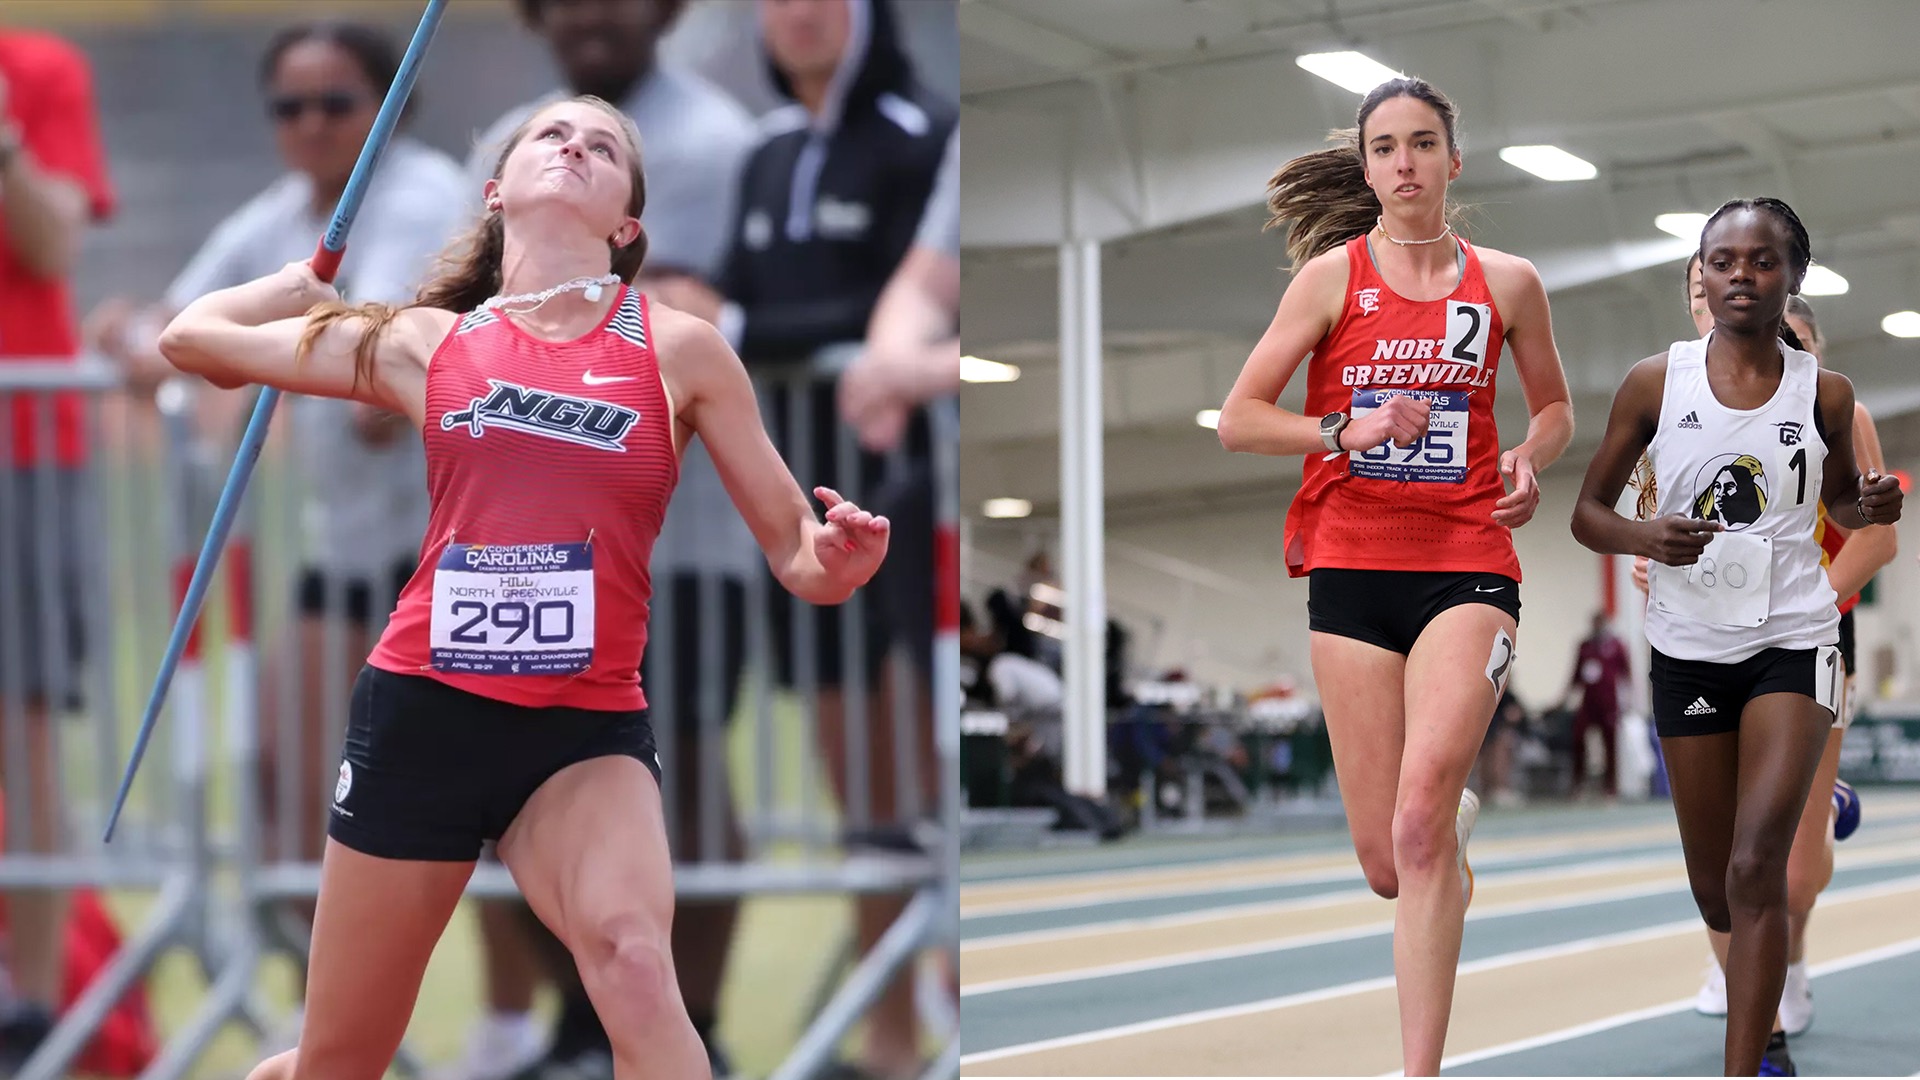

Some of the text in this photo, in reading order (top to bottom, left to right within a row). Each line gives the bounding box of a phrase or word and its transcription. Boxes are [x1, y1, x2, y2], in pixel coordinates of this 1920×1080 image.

[1452, 306, 1480, 363] 2
[1371, 339, 1445, 361] NORT
[1342, 364, 1494, 388] GREENVILLE
[479, 379, 640, 441] NGU
[1375, 393, 1449, 405] CAINAS
[1678, 422, 1702, 430] adidas
[1788, 448, 1806, 505] 1
[466, 549, 568, 567] CAROLINAS
[488, 544, 554, 552] CONFERENCE
[449, 586, 578, 598] NORTH GREENVILLE
[500, 577, 533, 587] HILL
[450, 600, 574, 644] 290
[1491, 637, 1512, 694] 2
[1826, 651, 1837, 707] 1
[1684, 707, 1717, 716] adidas
